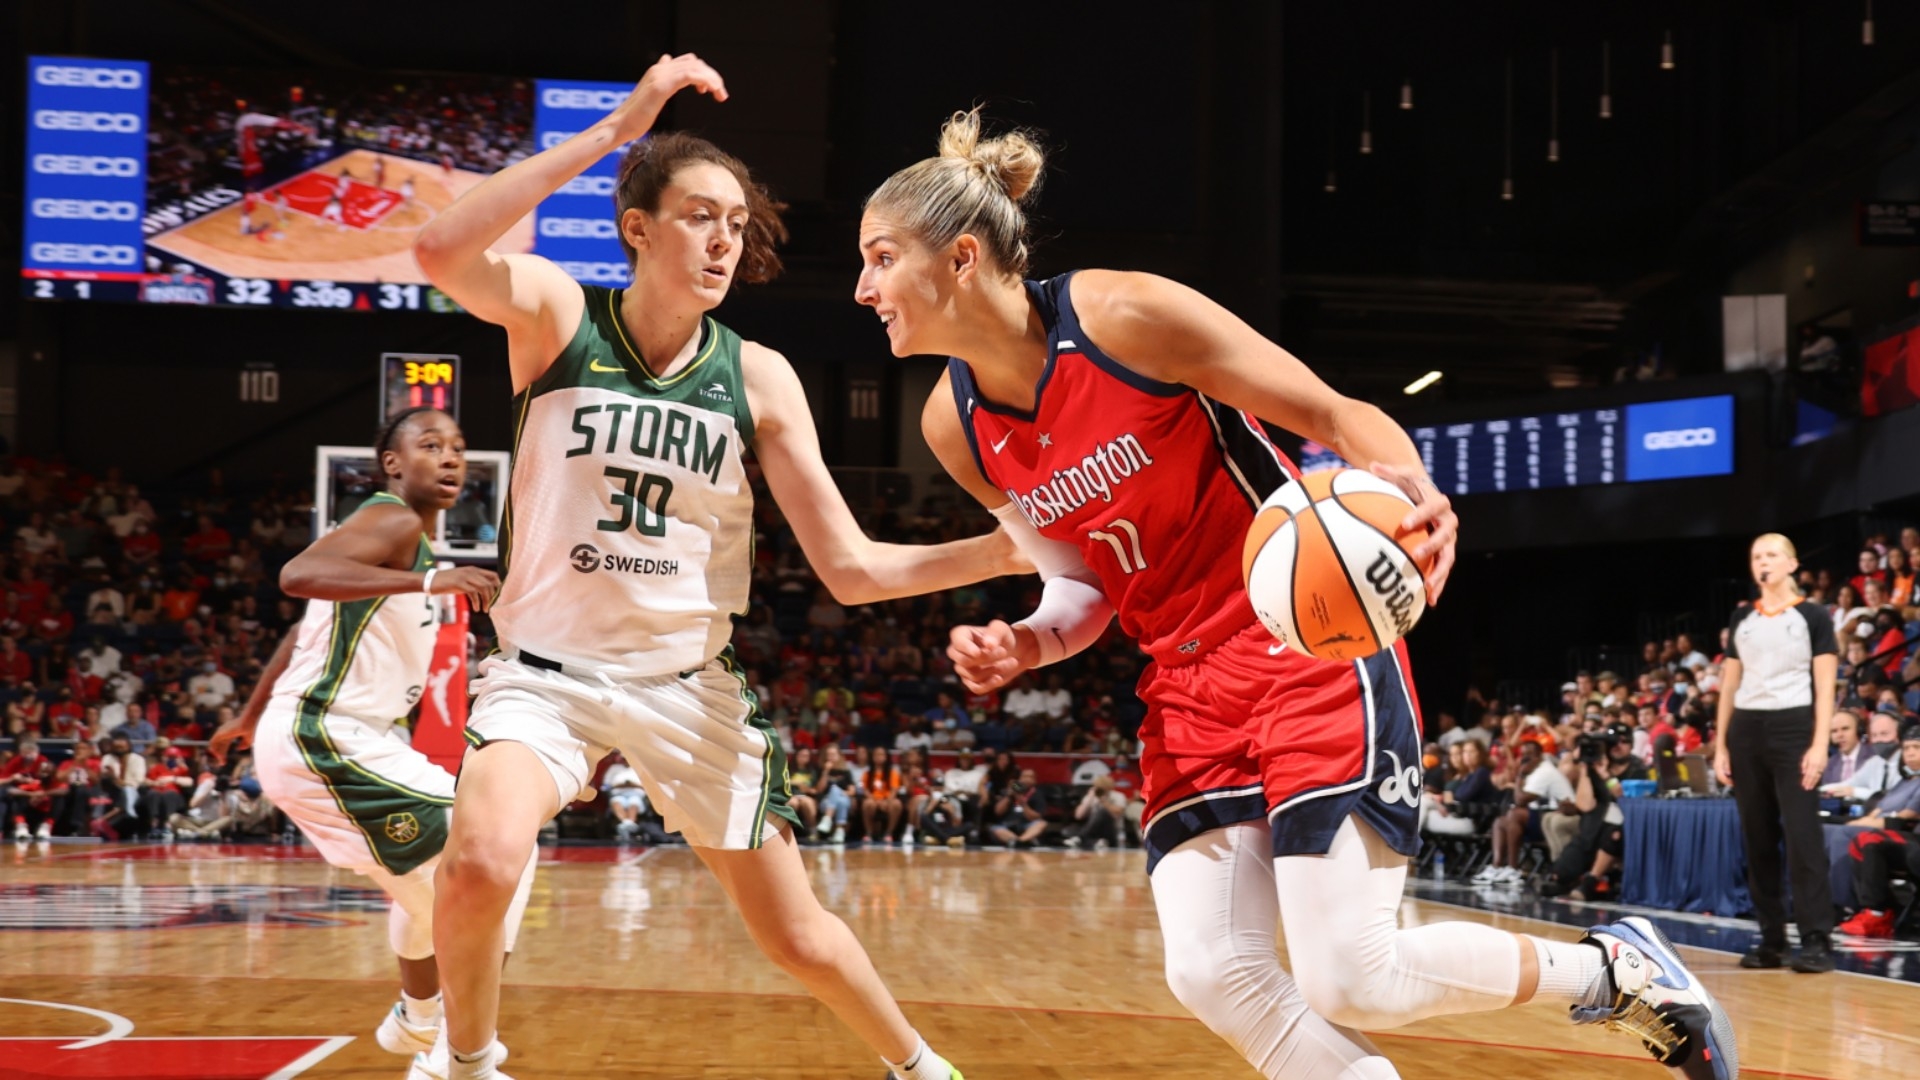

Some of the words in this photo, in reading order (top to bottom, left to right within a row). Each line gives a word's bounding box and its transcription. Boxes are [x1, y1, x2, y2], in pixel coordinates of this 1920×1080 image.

[35, 65, 142, 89] GEICO
[34, 109, 141, 133] GEICO
[33, 154, 140, 177] GEICO
[31, 198, 139, 221] GEICO
[540, 217, 618, 239] GEIC
[30, 242, 138, 265] GEICO
[34, 280, 54, 298] 2
[74, 281, 91, 299] 1
[226, 279, 271, 304] 32
[291, 286, 353, 308] 3:09
[378, 284, 419, 309] 31
[405, 362, 453, 385] 3:09
[240, 371, 279, 402] 110
[566, 403, 728, 486] STORM
[1643, 427, 1716, 450] GEICO
[597, 465, 674, 538] 30
[1088, 518, 1147, 575] 11
[603, 554, 679, 576] SWEDISH
[1365, 549, 1414, 635] Wilso
